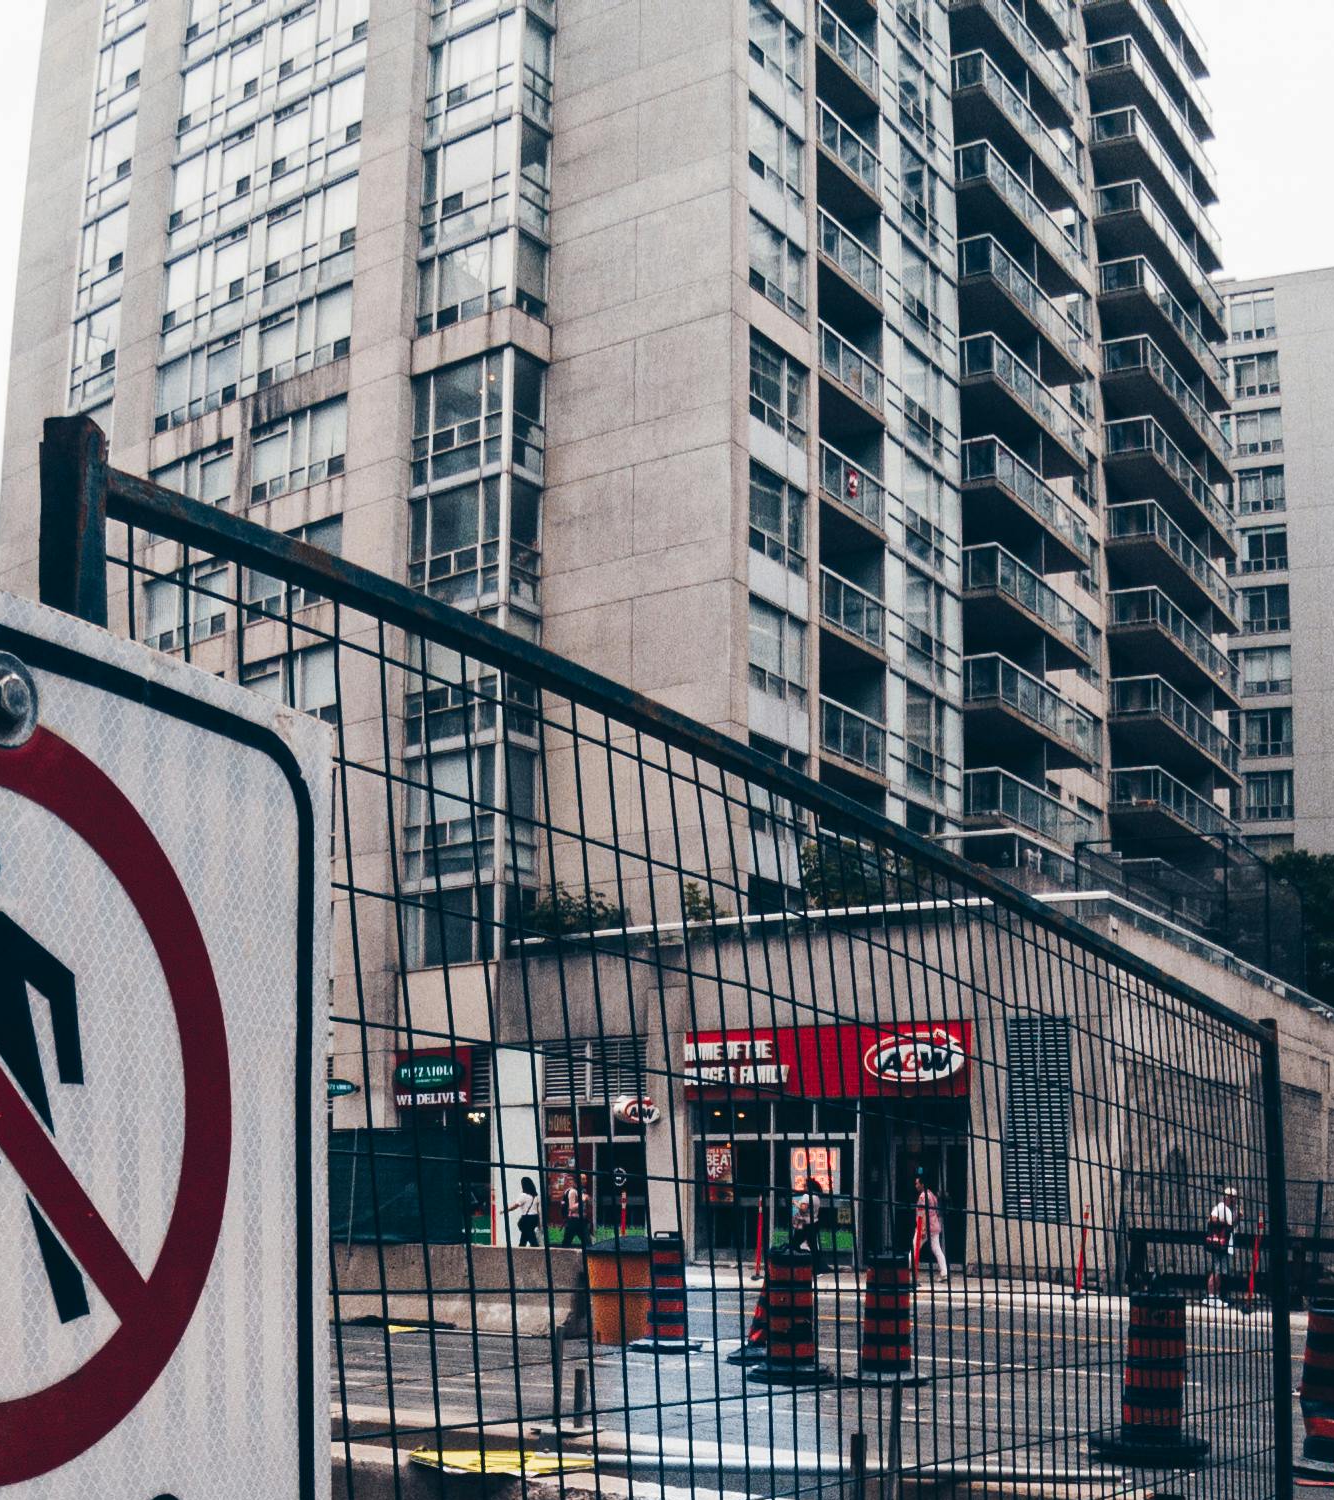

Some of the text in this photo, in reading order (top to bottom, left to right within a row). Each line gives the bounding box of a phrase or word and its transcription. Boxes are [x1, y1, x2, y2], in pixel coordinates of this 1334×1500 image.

[684, 1042, 724, 1061] HOME
[880, 1050, 952, 1073] A&W
[396, 1094, 414, 1106] WE
